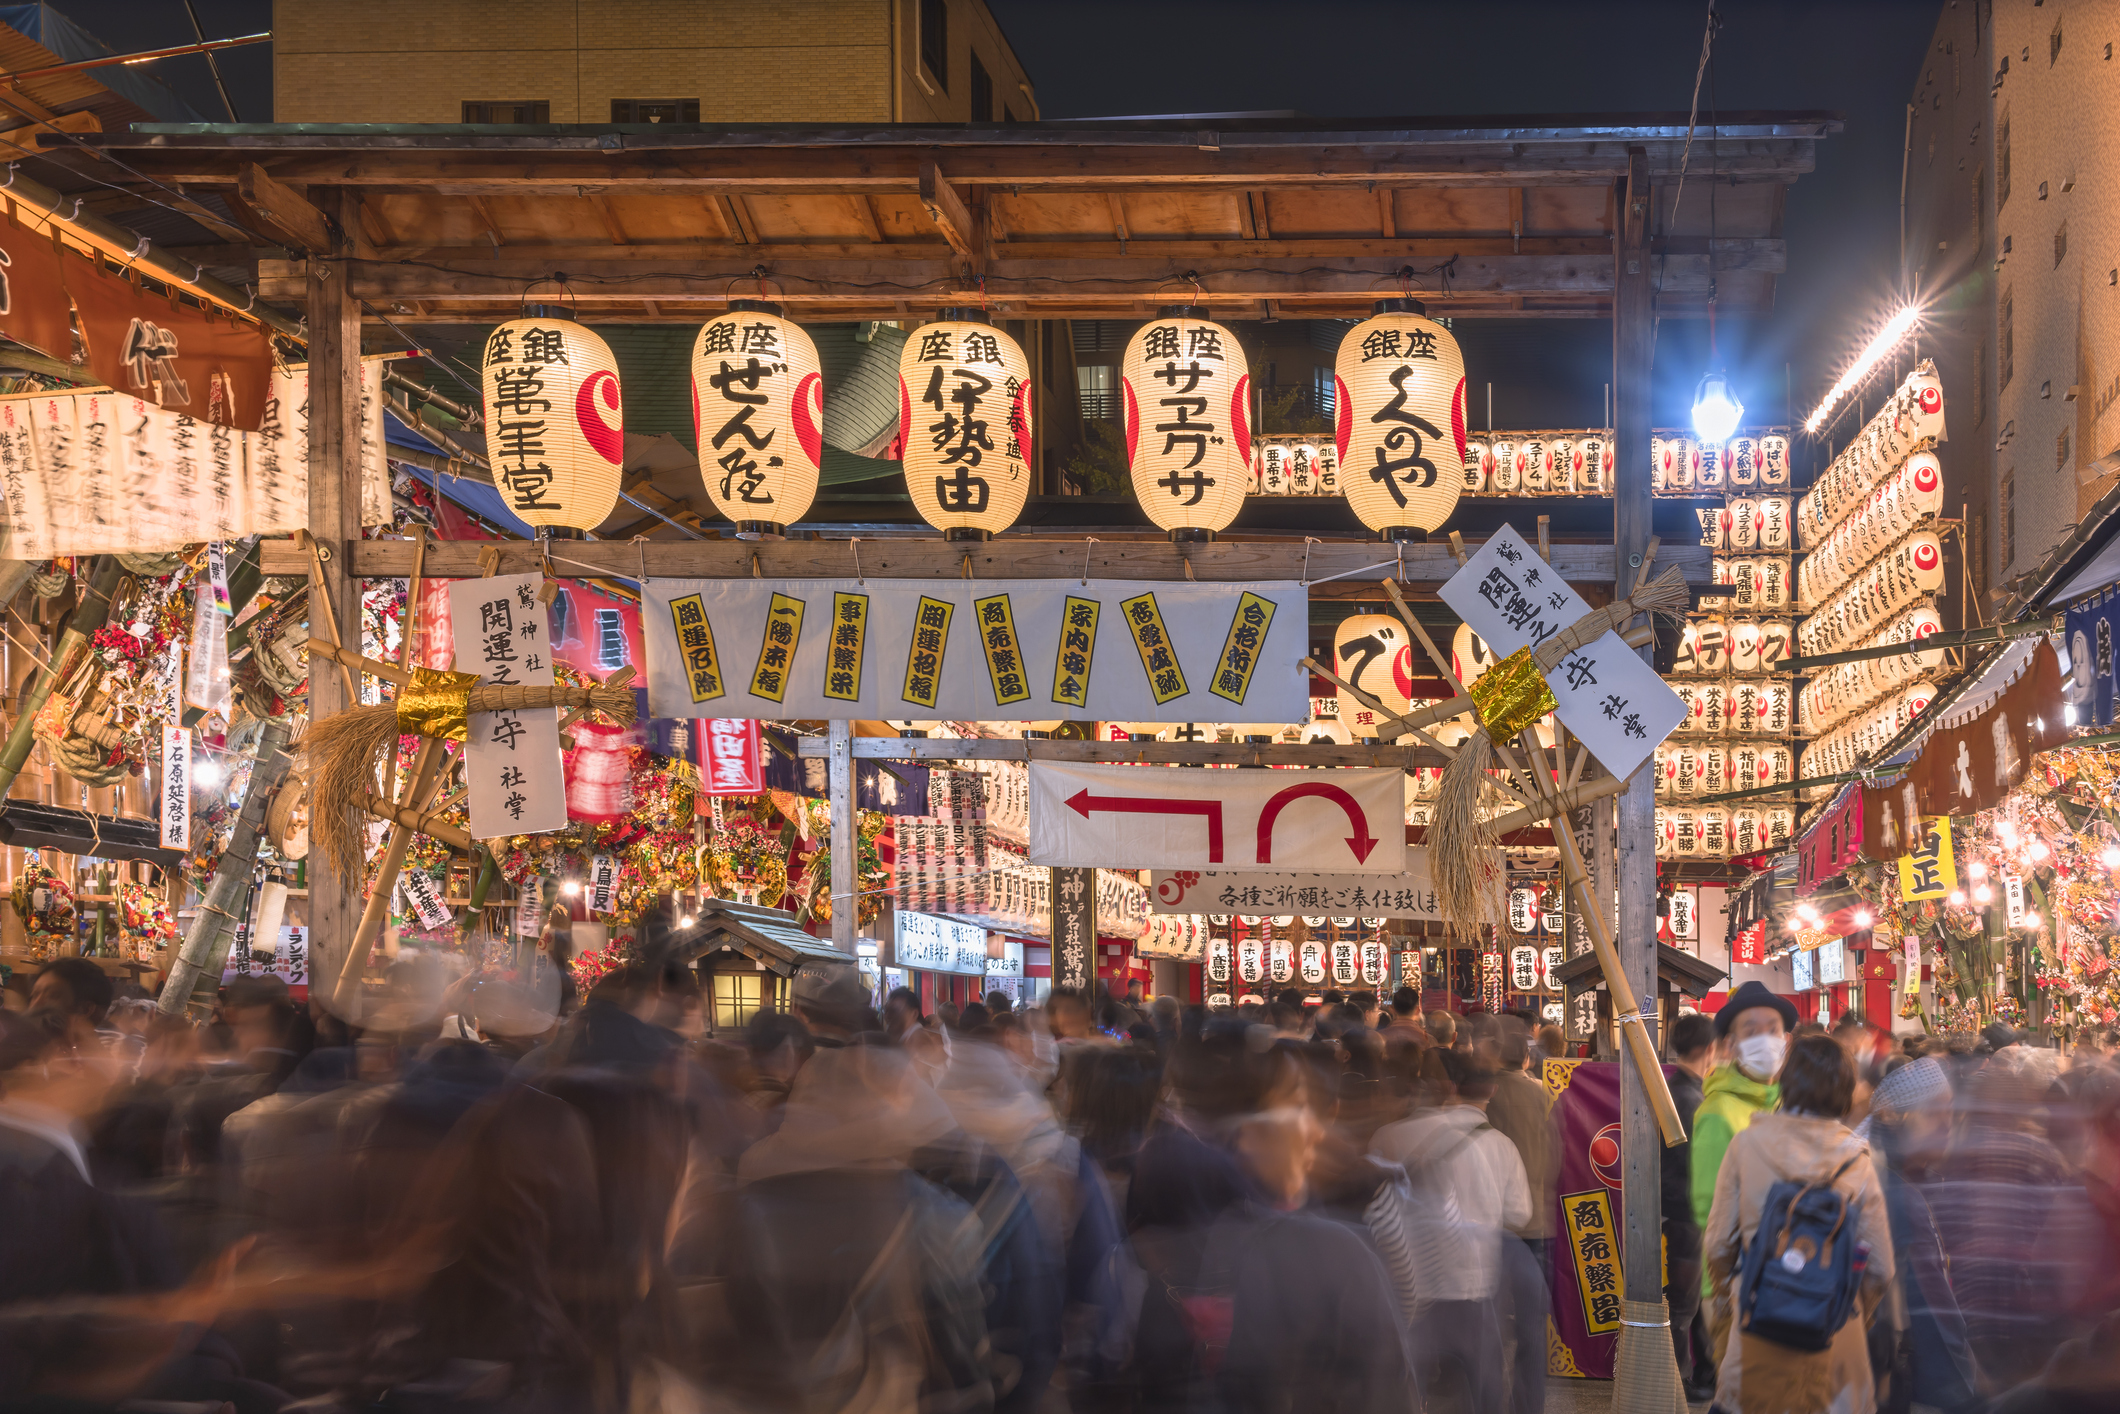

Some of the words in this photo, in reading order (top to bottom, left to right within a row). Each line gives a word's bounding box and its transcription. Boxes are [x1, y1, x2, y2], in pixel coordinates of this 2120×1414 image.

[704, 321, 780, 358] 銀座
[1144, 326, 1225, 363] 銀座
[1361, 329, 1438, 363] 銀座
[922, 365, 994, 513] 伊勢由
[1004, 375, 1024, 481] 金春通り
[1369, 364, 1444, 508] くのや
[1763, 440, 1784, 450] 洋食
[1267, 448, 1281, 488] 亜希子
[1321, 458, 1336, 486] 千石
[1464, 447, 1481, 486] 誠吾
[1702, 451, 1719, 482] ユタカ
[1495, 539, 1570, 612] 鷲神社
[1737, 565, 1753, 604] 尾張屋
[1767, 563, 1781, 604] 浅草市場
[515, 583, 545, 673] 鷲神社
[675, 600, 718, 696] 開運厄除
[1217, 601, 1267, 697] 合格祈願
[1477, 566, 1598, 692] 開運之守
[908, 603, 946, 702] 開運招福
[1059, 603, 1095, 700] 家内安全
[479, 598, 527, 751] 開運之守
[1678, 687, 1694, 730] 米店
[1706, 687, 1722, 730] 米久本店
[1740, 687, 1756, 731] 米久本店
[1771, 687, 1788, 730] 米久本店
[1303, 945, 1320, 980] 舟和
